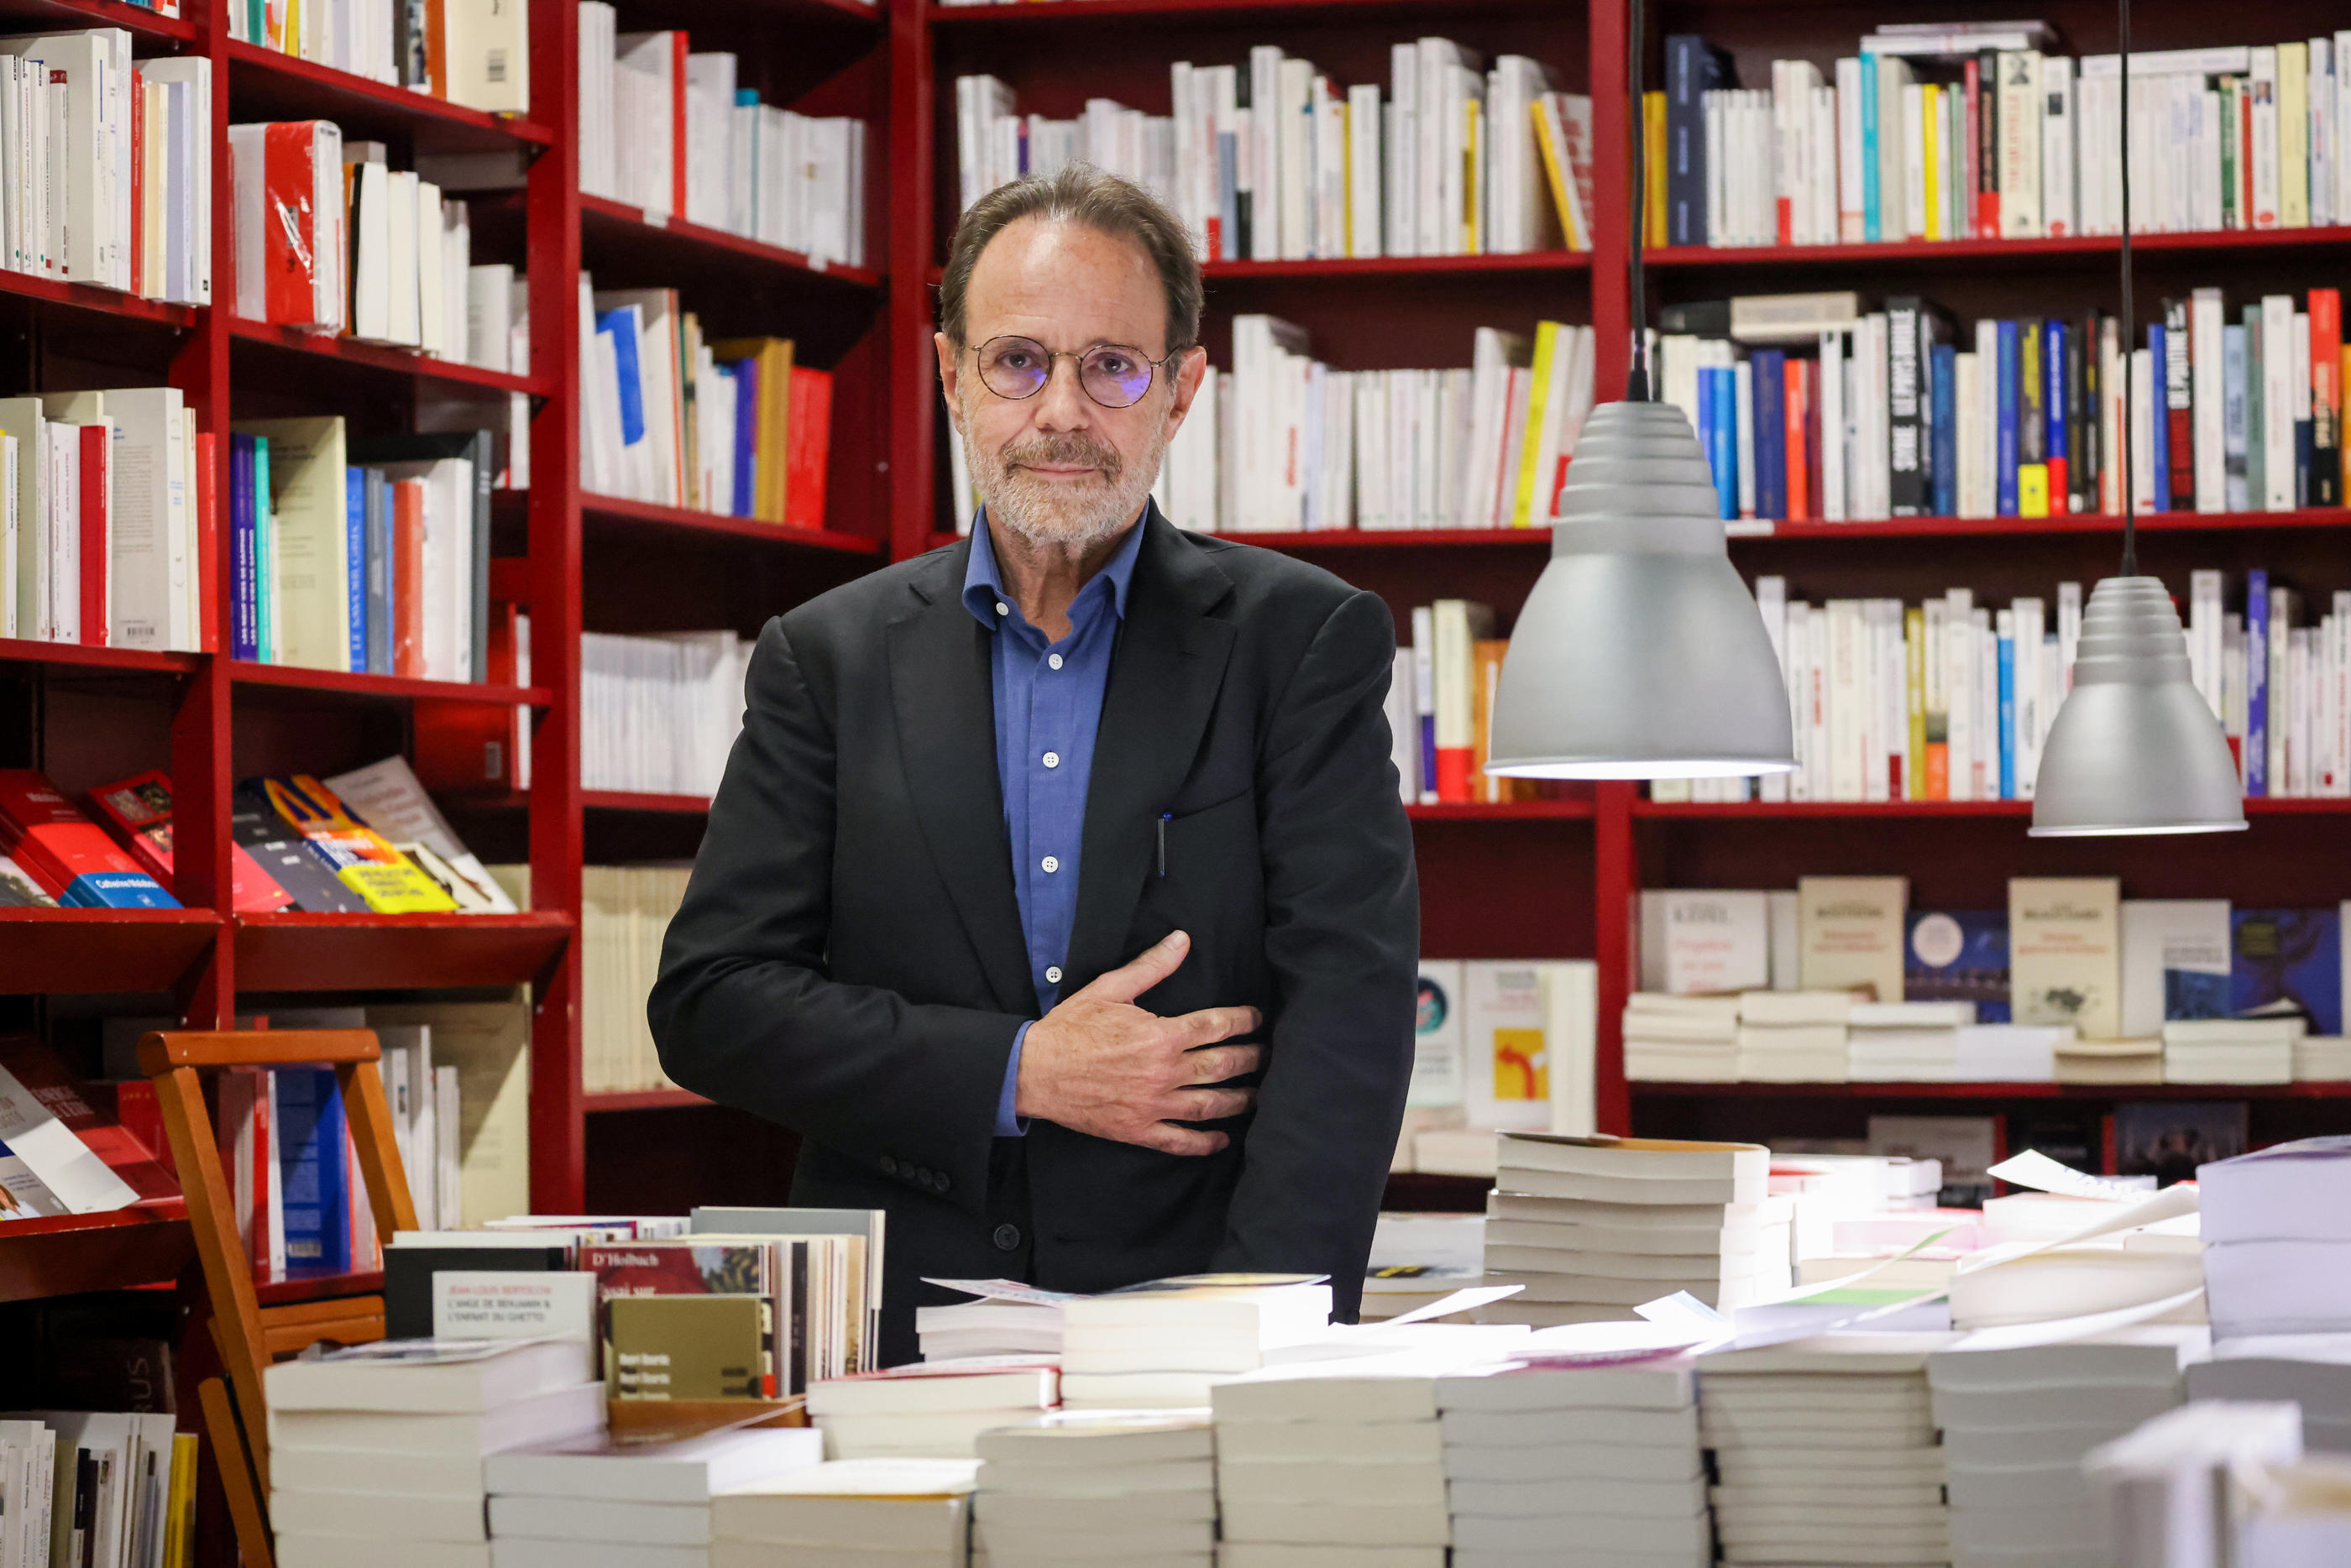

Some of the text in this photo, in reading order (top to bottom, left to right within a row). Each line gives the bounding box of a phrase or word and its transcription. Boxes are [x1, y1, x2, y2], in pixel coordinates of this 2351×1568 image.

[592, 1253, 659, 1267] D'Holbach
[633, 1287, 656, 1298] sur
[483, 1299, 494, 1309] DE
[492, 1312, 505, 1322] DU
[508, 1312, 546, 1322] GHETTO
